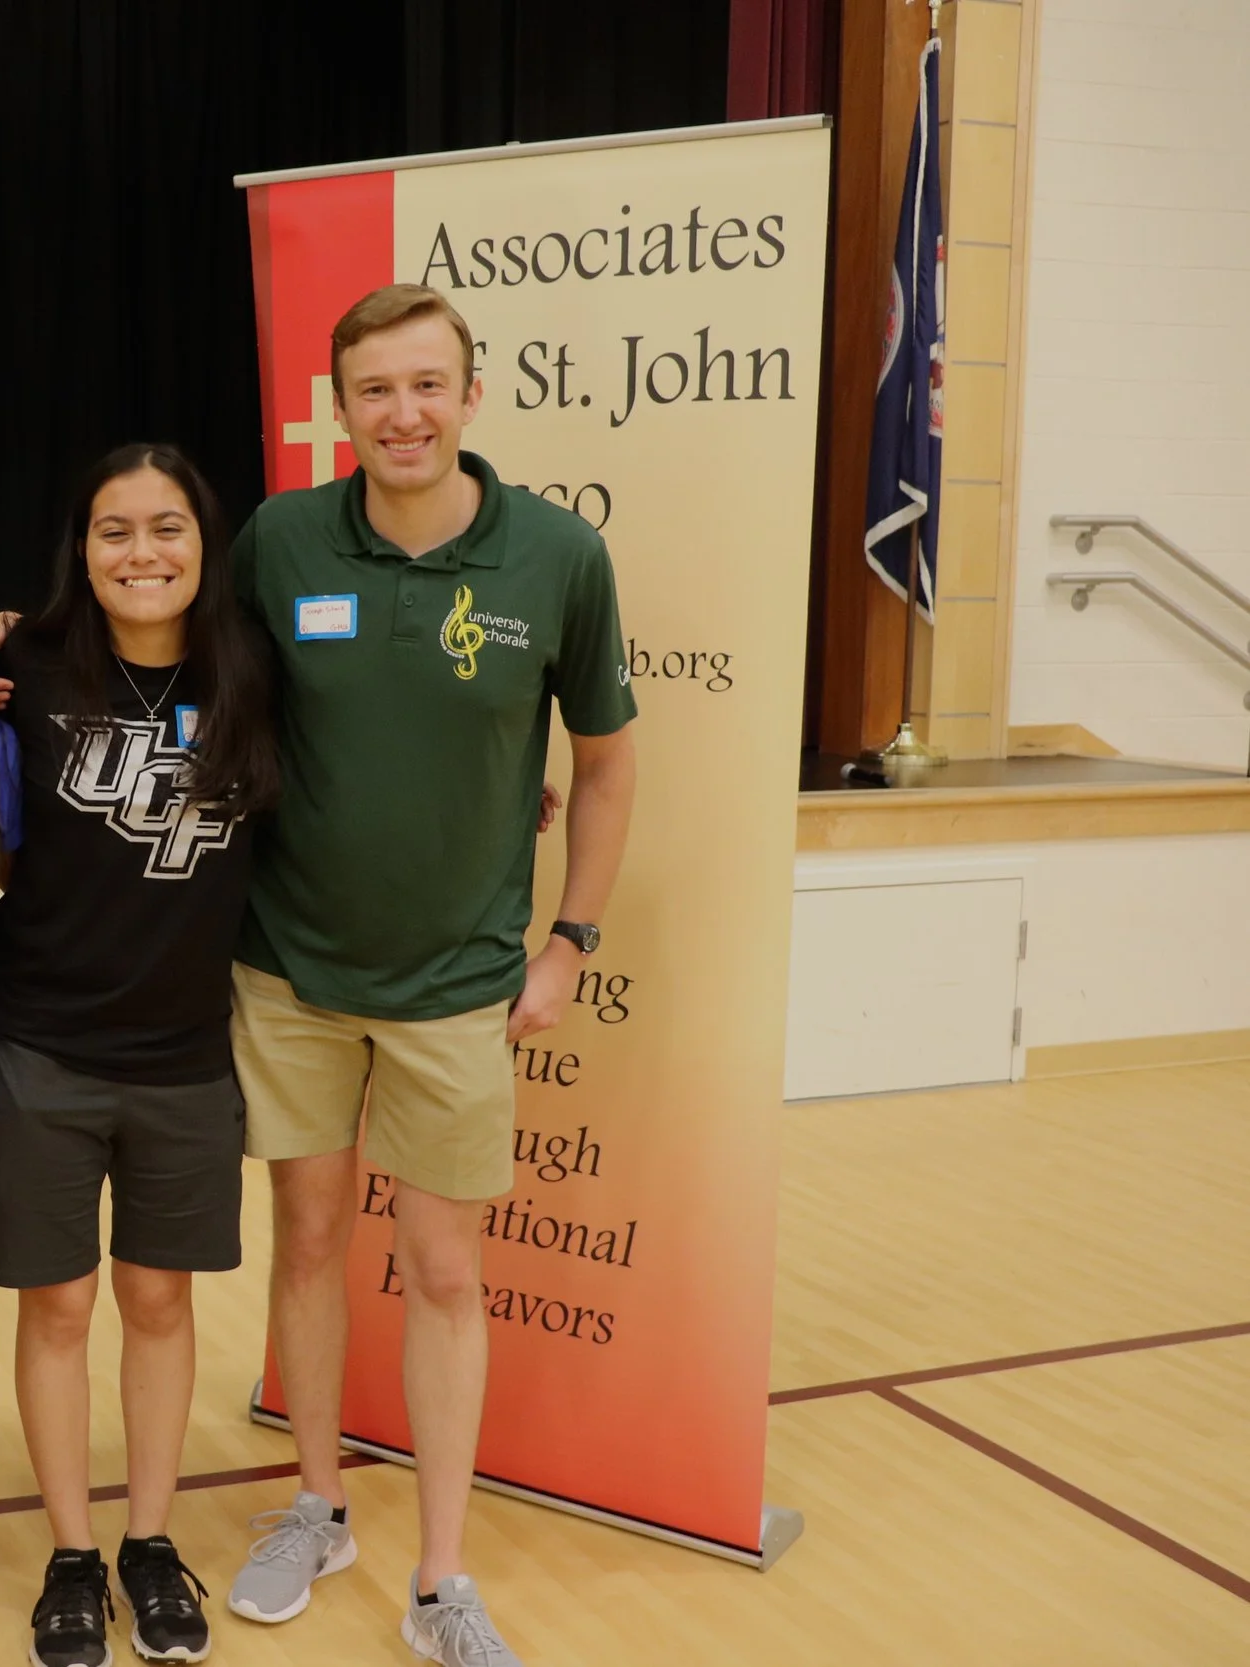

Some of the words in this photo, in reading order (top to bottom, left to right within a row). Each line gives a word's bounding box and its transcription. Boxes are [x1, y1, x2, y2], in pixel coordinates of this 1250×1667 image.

[421, 204, 785, 289] Associates
[516, 340, 592, 411] St.
[610, 326, 795, 428] John
[468, 612, 530, 636] university
[483, 629, 530, 649] chorale
[628, 639, 735, 692] b.org
[54, 717, 239, 877] UCF
[513, 1040, 580, 1087] tue
[360, 1172, 638, 1268] Eational
